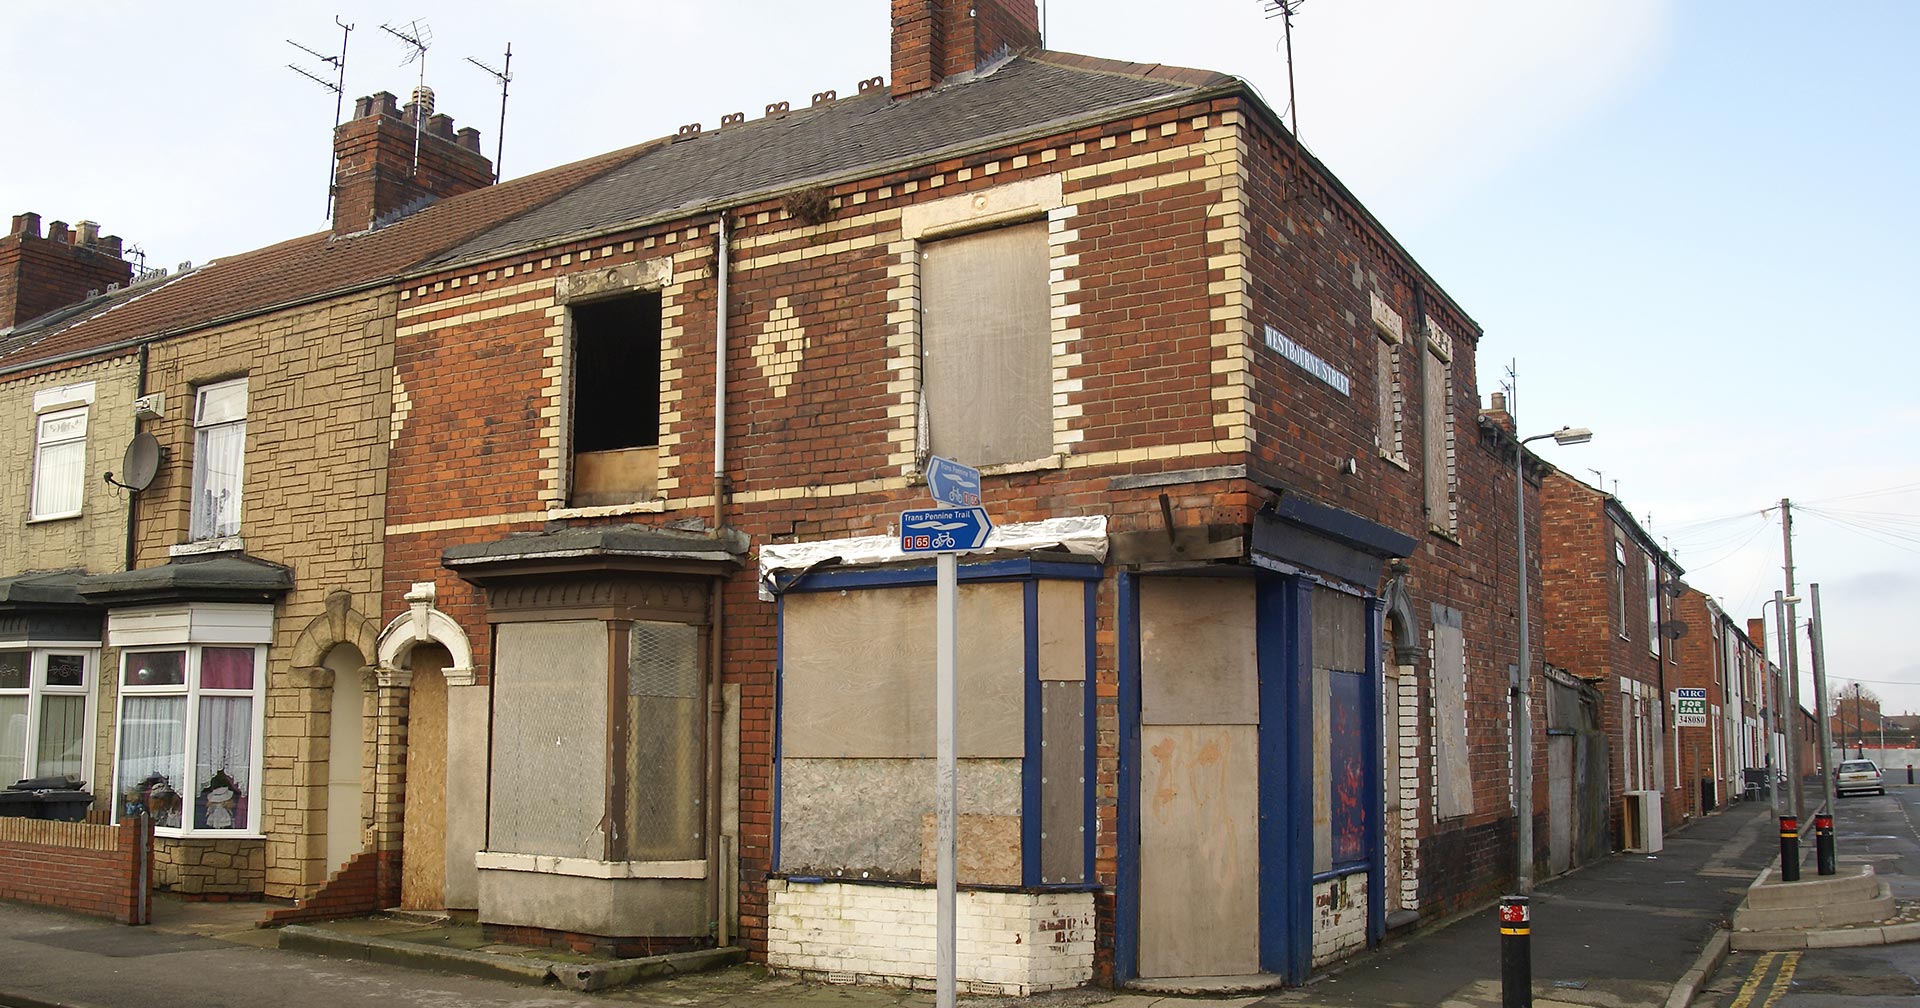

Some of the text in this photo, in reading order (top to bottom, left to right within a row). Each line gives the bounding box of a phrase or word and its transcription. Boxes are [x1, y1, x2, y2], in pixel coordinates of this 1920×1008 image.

[1265, 325, 1350, 397] WESTBOURNE STREET
[941, 461, 952, 472] Trans
[904, 513, 923, 521] Trans
[925, 512, 953, 520] Pennine
[916, 537, 928, 547] 65
